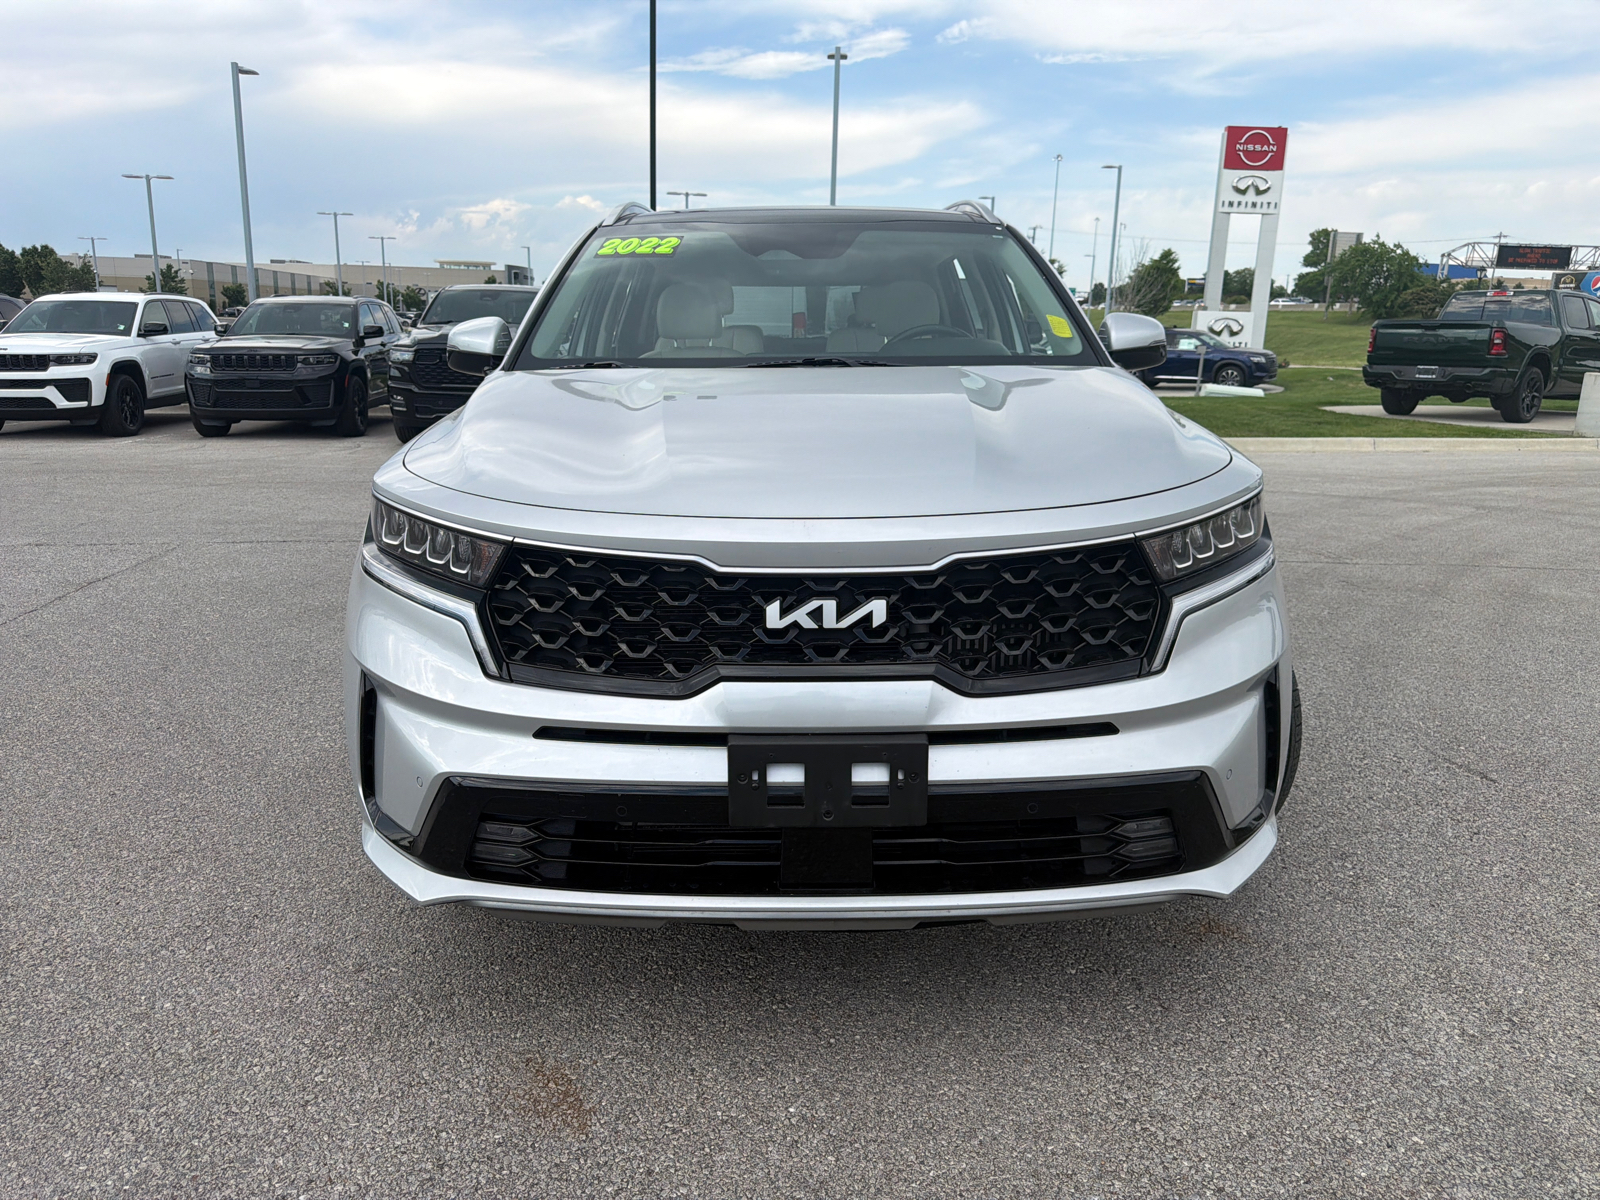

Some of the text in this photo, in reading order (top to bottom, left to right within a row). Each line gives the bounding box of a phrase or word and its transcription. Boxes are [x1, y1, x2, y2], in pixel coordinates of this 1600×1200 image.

[1221, 200, 1278, 209] INFINITI
[597, 237, 681, 255] 2022
[1402, 336, 1454, 344] RAM
[765, 598, 888, 629] KIA
